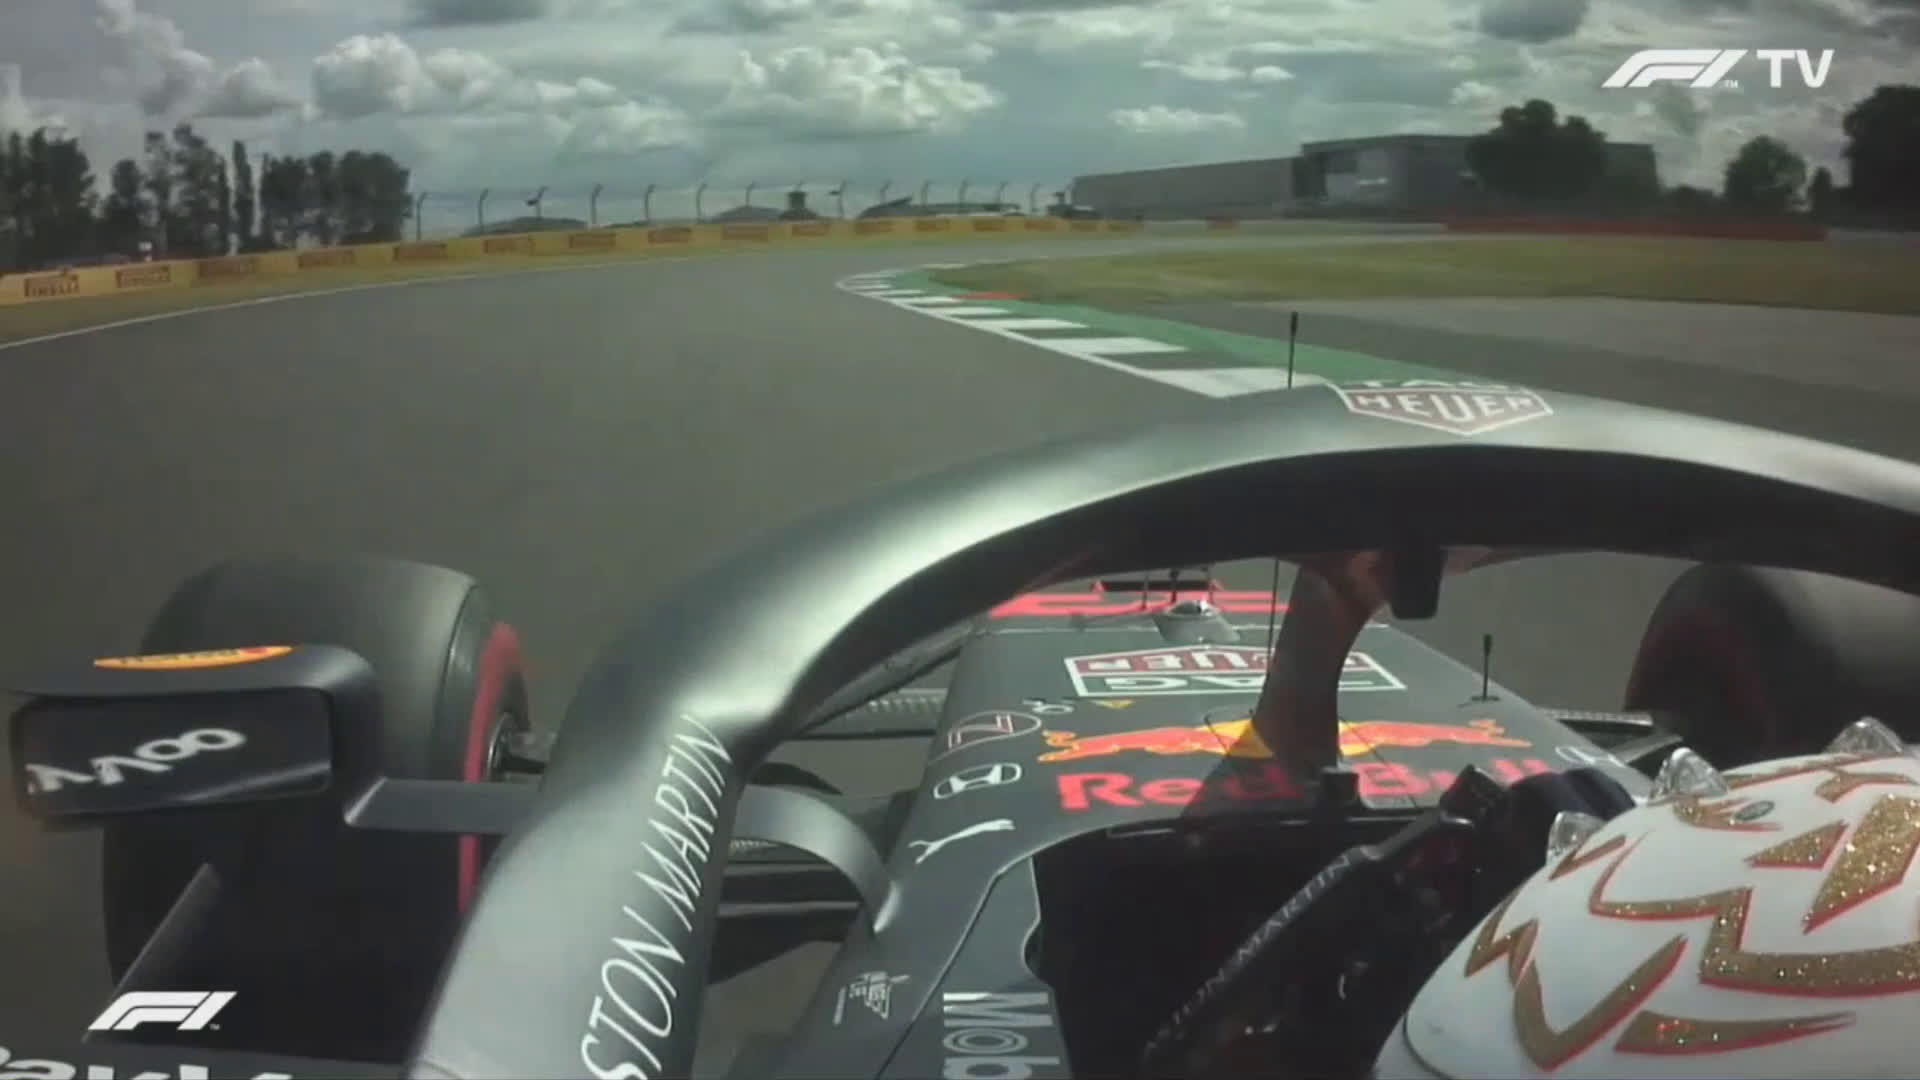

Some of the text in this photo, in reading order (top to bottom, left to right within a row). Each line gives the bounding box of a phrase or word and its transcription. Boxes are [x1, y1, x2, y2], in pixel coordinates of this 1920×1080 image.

[1355, 393, 1534, 423] HEUER
[581, 713, 732, 1080] STON MARTIN
